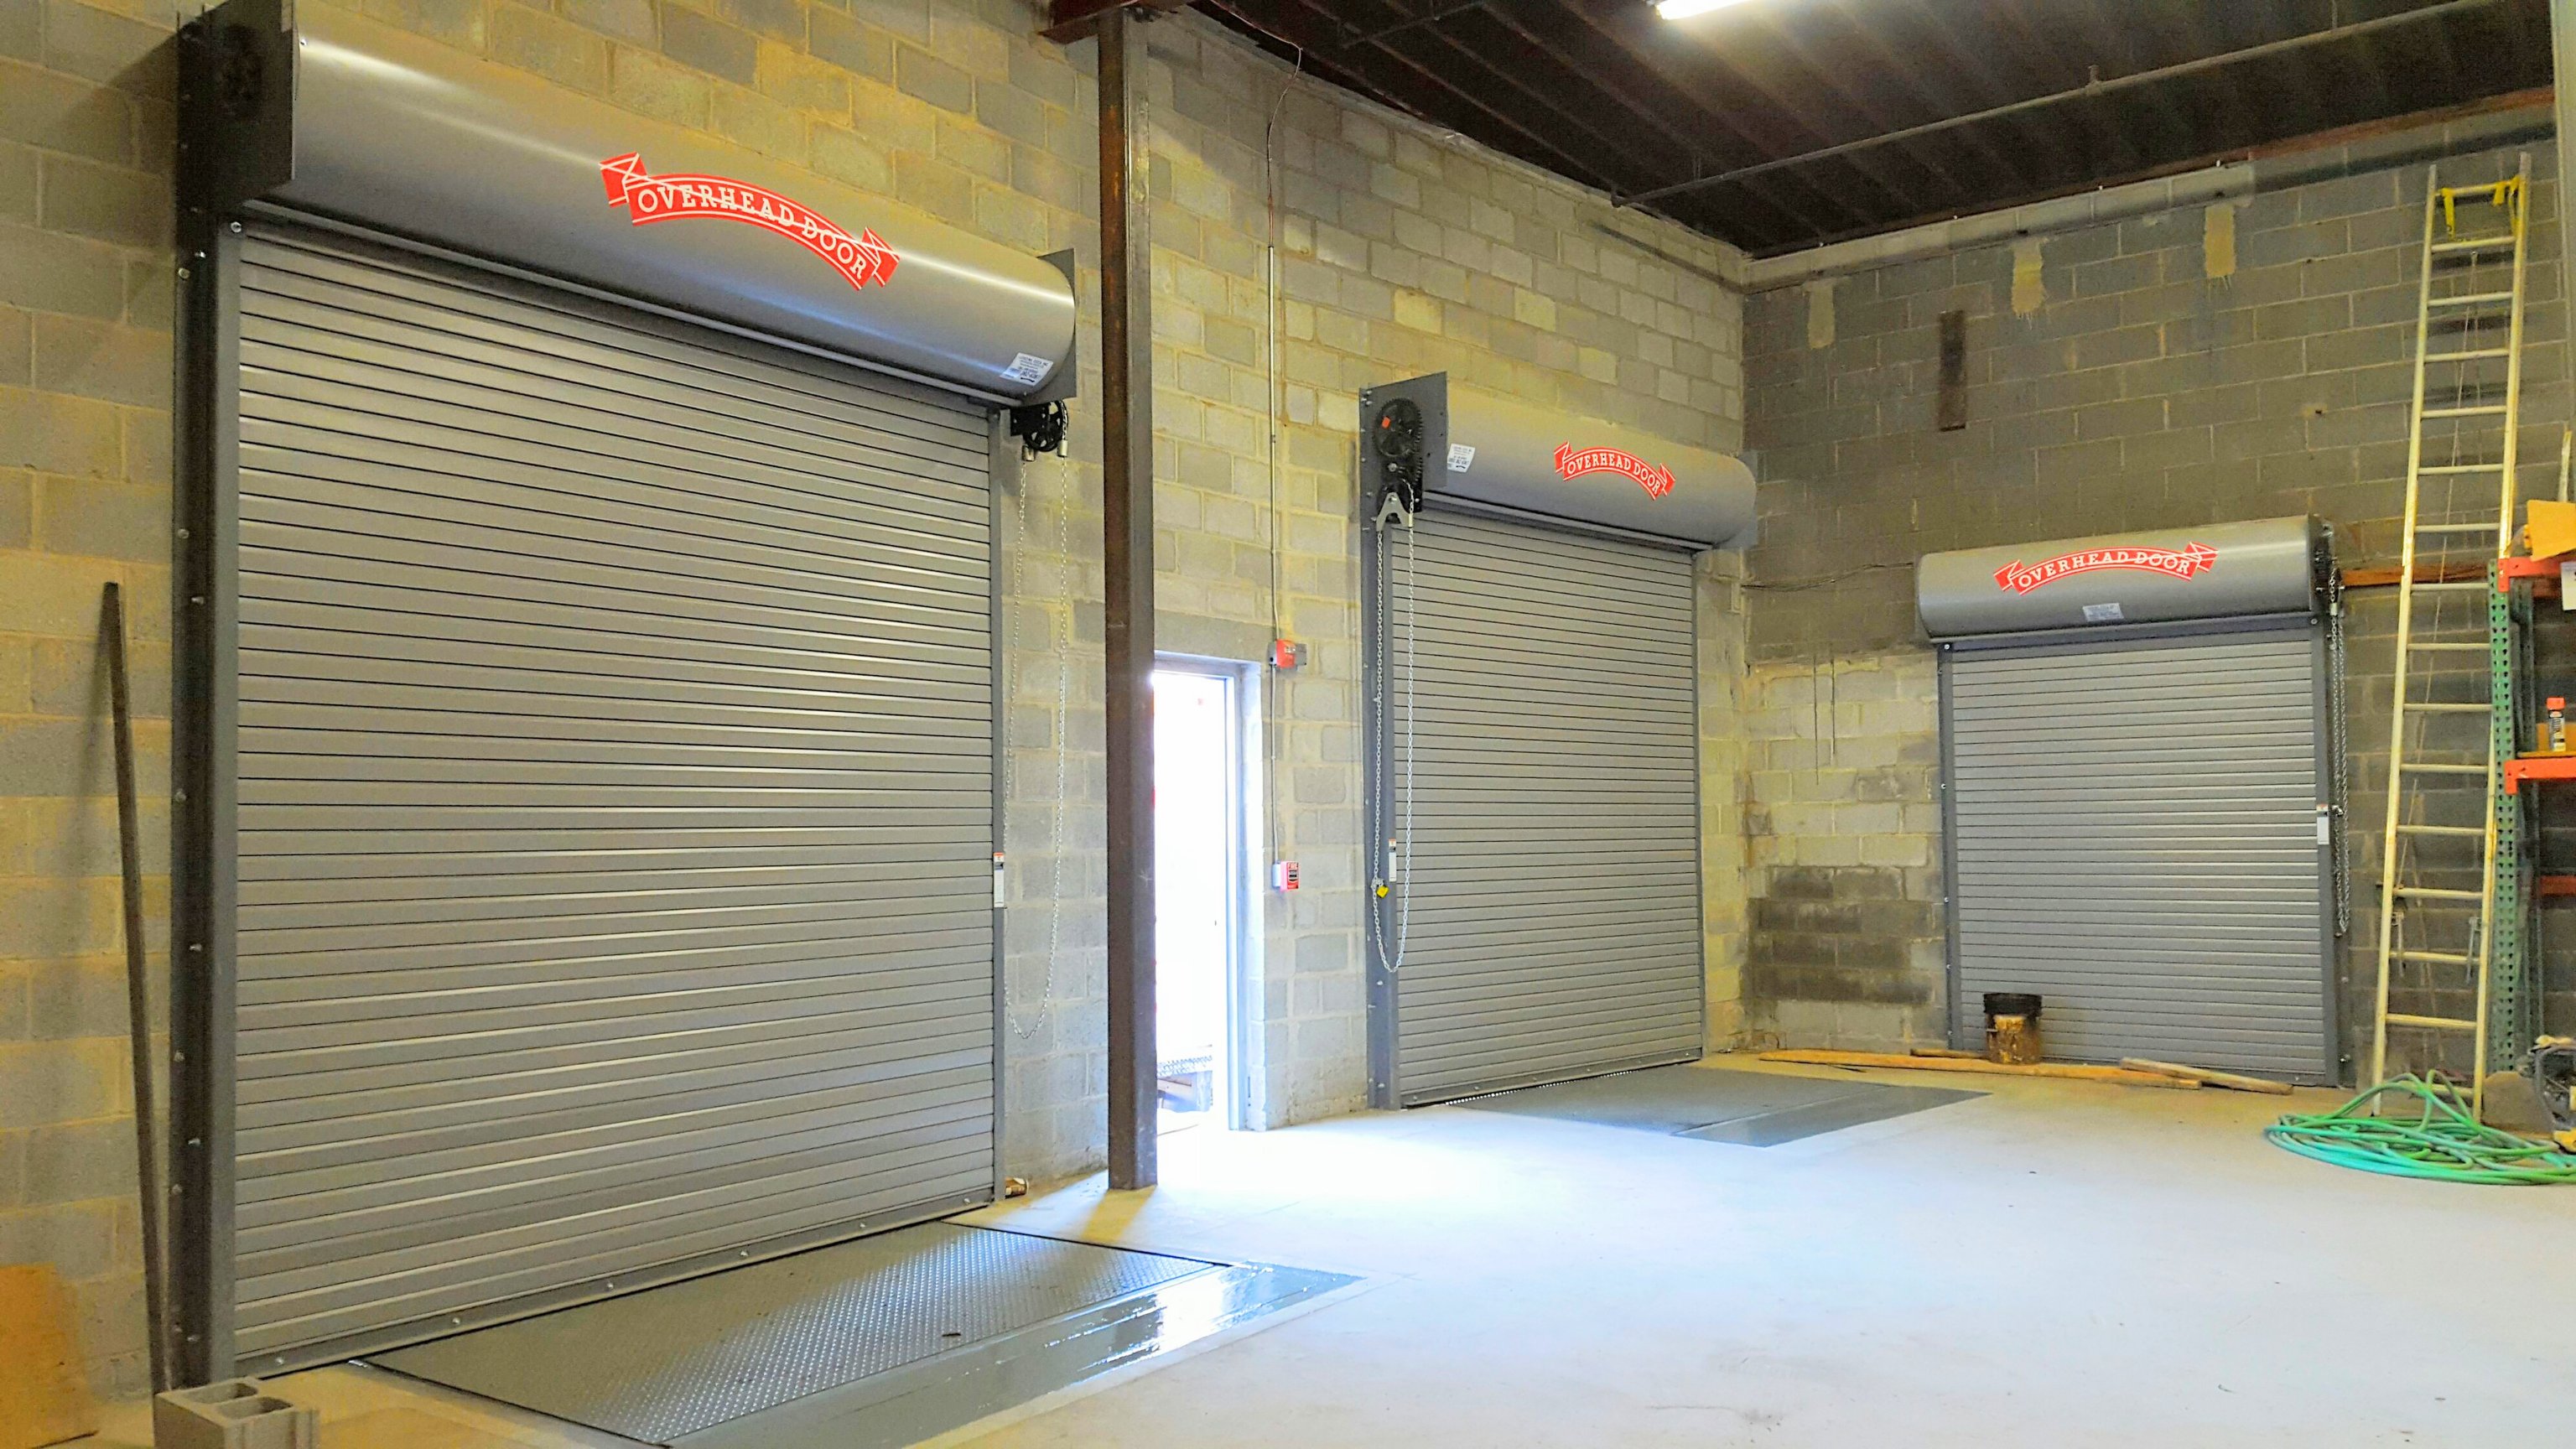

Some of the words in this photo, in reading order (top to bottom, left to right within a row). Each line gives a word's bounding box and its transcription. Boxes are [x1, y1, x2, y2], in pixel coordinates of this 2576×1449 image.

[637, 184, 795, 226] OVERHEAD
[800, 219, 867, 279] DOOR
[1567, 453, 1631, 474] OVERHEAD
[1633, 462, 1661, 494] DOOR
[2018, 551, 2129, 588] OVERHEAD
[2133, 552, 2193, 574] DOOR
